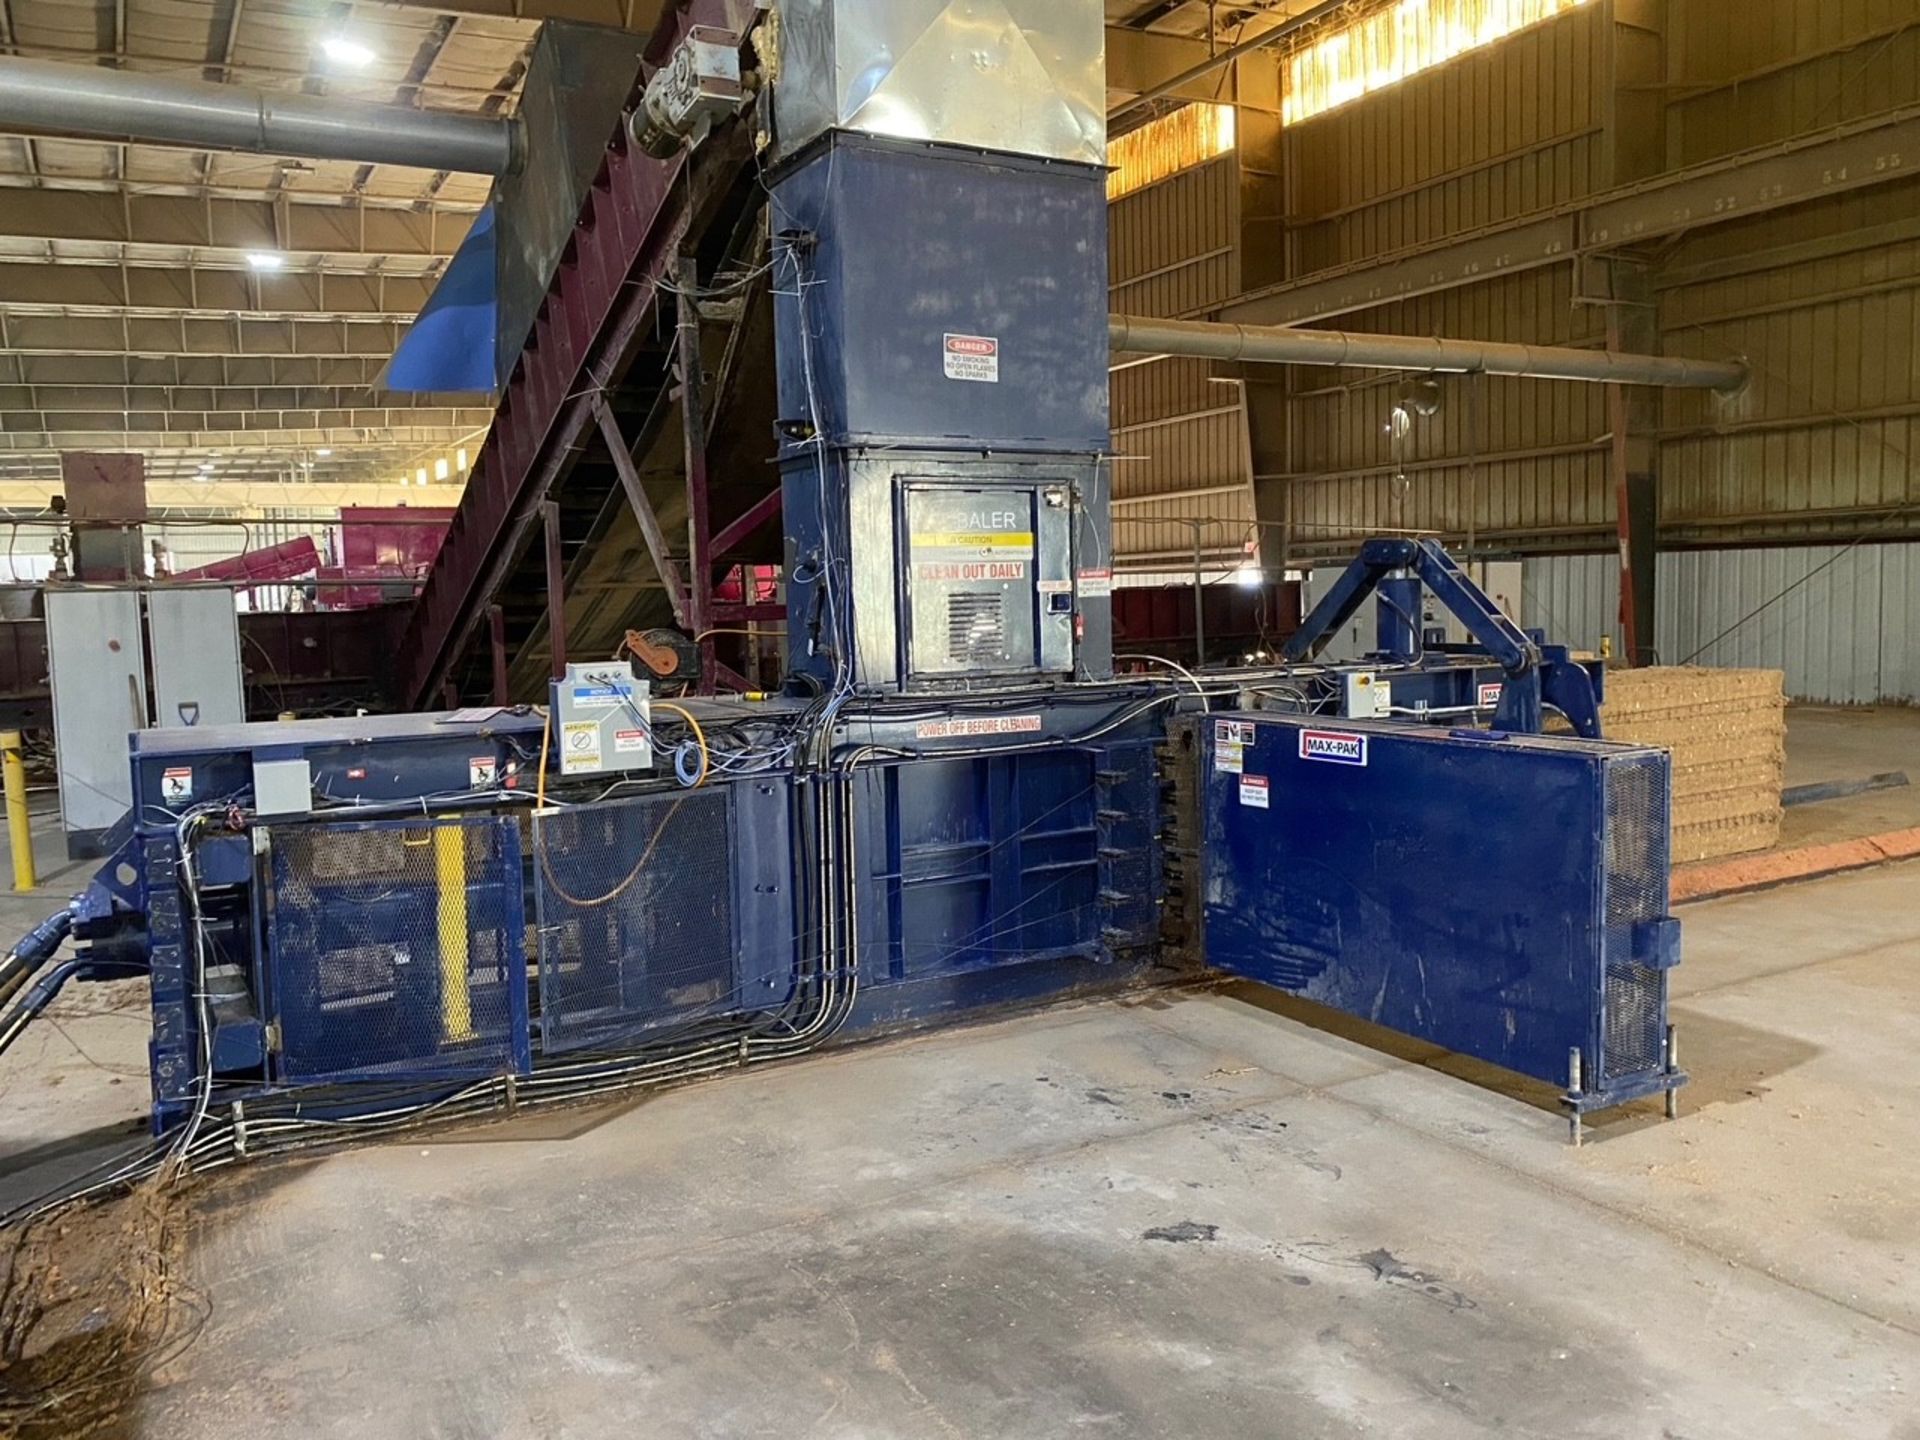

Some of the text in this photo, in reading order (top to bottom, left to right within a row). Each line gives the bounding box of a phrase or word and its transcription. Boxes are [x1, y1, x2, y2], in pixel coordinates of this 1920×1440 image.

[1822, 167, 1848, 185] 54
[1874, 153, 1901, 171] 55
[954, 340, 988, 351] DANGER
[946, 361, 955, 369] NO
[955, 362, 972, 370] OPEN
[952, 354, 990, 365] NO SMOKING
[954, 369, 988, 379] NO SPARKS
[958, 511, 1017, 529] BALER
[959, 535, 993, 544] CAUTION
[920, 563, 1022, 580] CLEAN OUT DAILY
[917, 723, 948, 737] POWER
[949, 722, 965, 735] OFF
[967, 720, 999, 734] BEFORE
[1307, 738, 1359, 756] MAX-PAK
